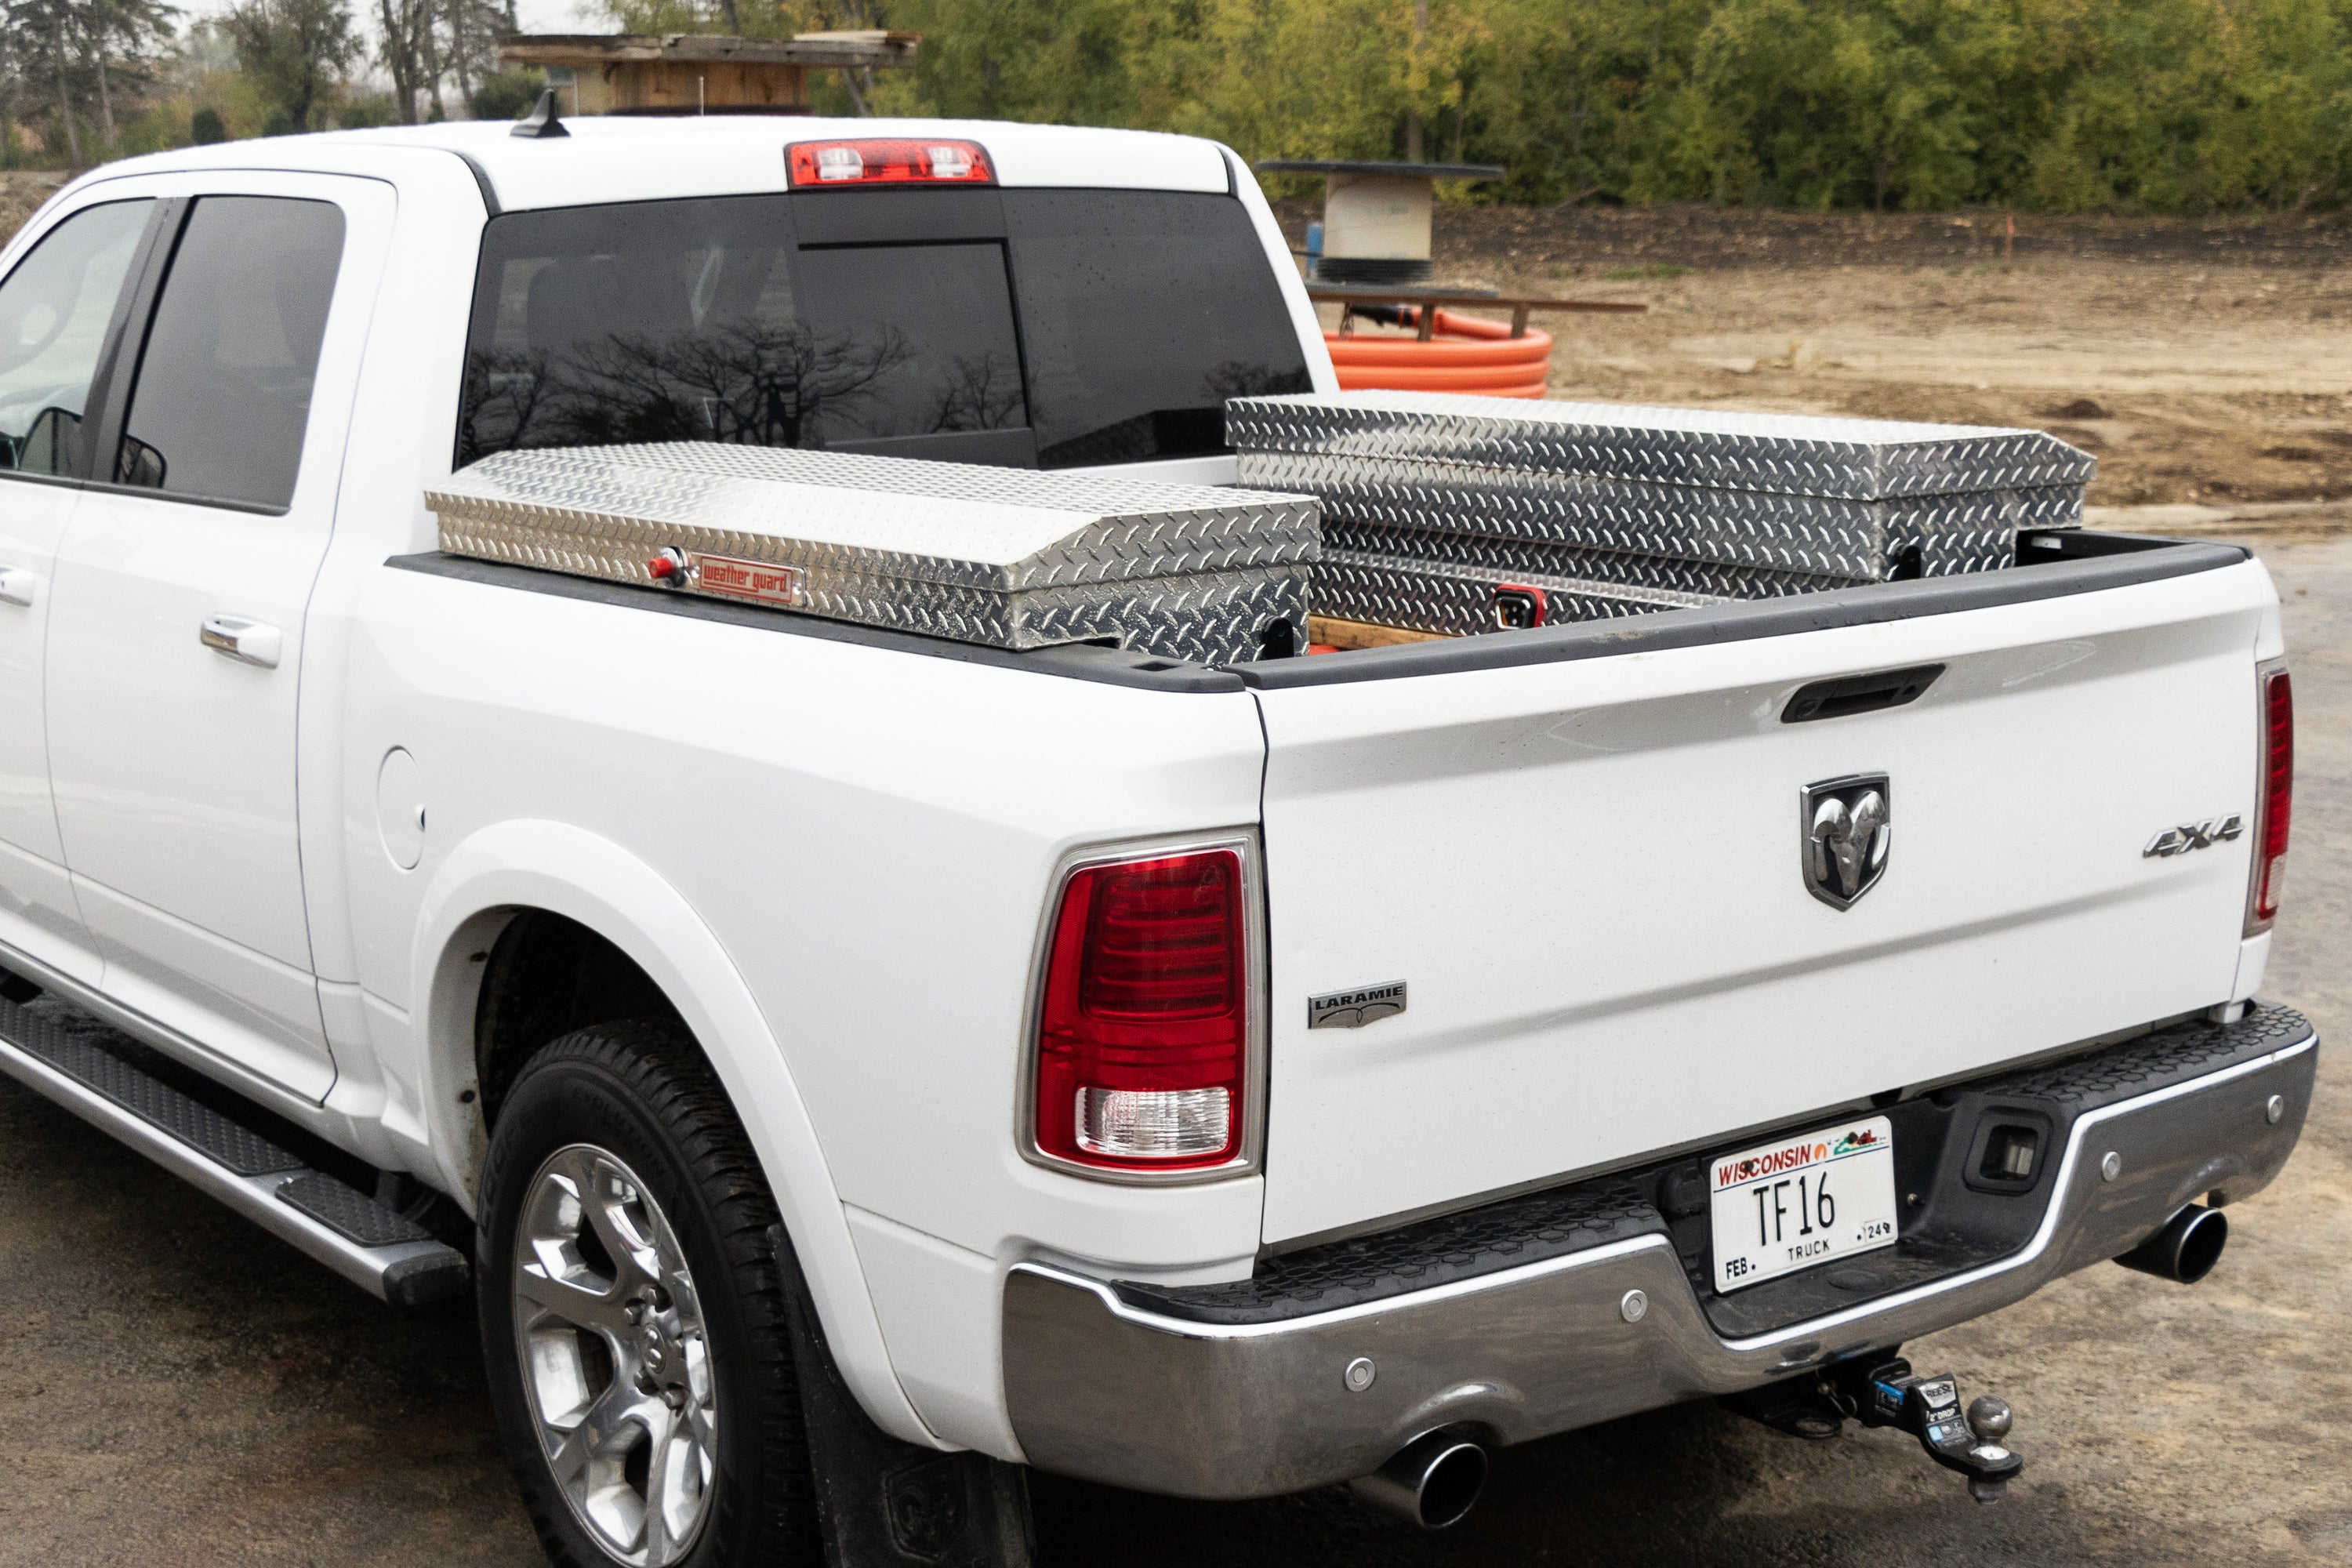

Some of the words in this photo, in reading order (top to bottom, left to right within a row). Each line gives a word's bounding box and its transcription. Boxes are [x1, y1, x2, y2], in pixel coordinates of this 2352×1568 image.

[703, 564, 750, 586] weather
[752, 572, 787, 593] guard
[1315, 985, 1403, 1011] LARAMIE
[1719, 1144, 1812, 1187] WISCONSIN
[1753, 1171, 1835, 1247] TF16
[1788, 1239, 1830, 1261] TRUCK
[1936, 1407, 1956, 1420] DROP
